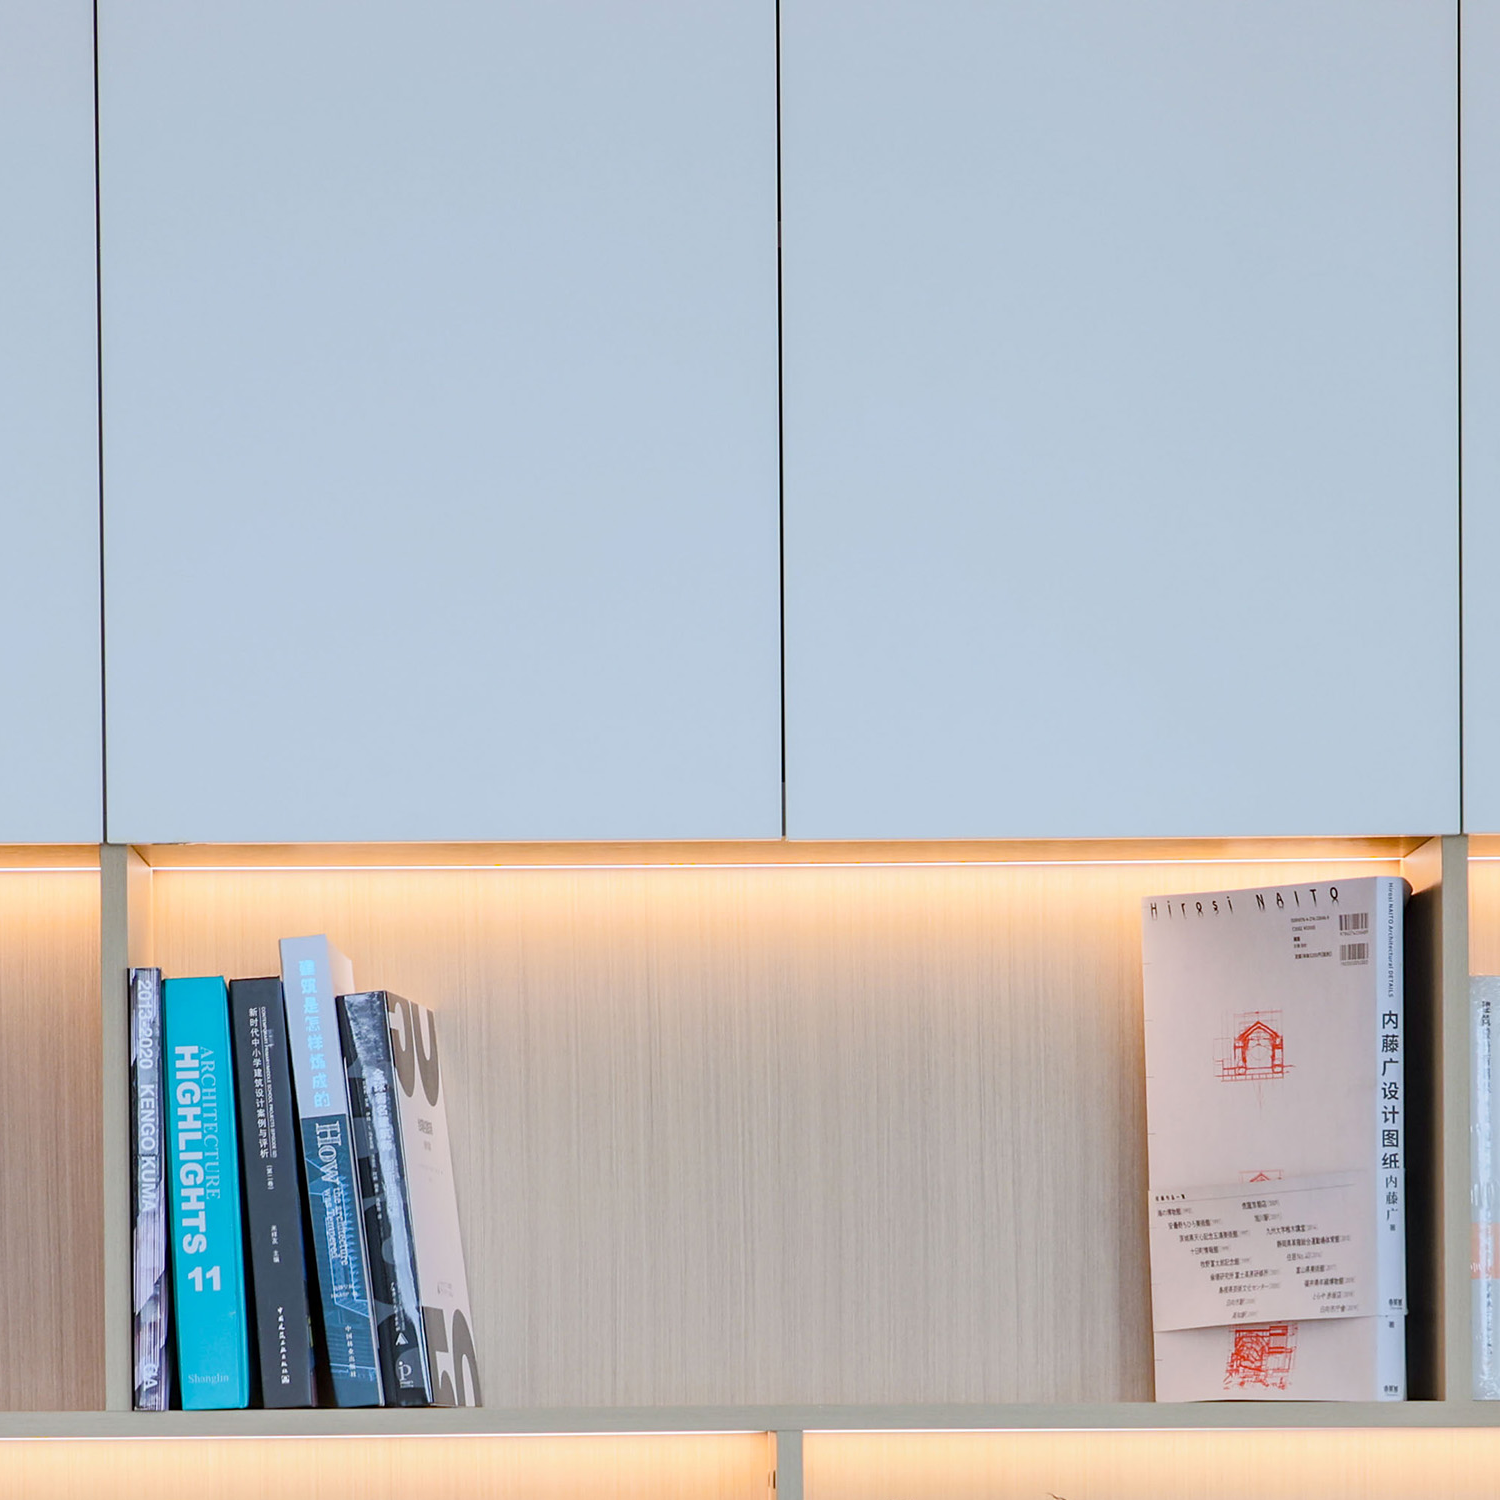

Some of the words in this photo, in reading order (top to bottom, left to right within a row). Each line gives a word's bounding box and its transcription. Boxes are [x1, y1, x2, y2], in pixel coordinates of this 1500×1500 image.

[1151, 896, 1234, 920] Hirosi
[1256, 887, 1340, 911] NAITO
[137, 980, 153, 1069] 2013-2020
[299, 960, 331, 1107] 建筑是怎样炼成的
[140, 1084, 155, 1150] KENGO
[248, 1008, 269, 1158] 新时代中小学建筑设计案例与评析
[1381, 1010, 1399, 1169] 内藤广设计图纸
[175, 1046, 207, 1254] HIGHLIGHTS
[200, 1047, 221, 1199] ARCHITECTURE
[141, 1156, 156, 1212] KUMA
[333, 1187, 343, 1204] the
[335, 1205, 348, 1266] architecture
[188, 1266, 221, 1292] 11
